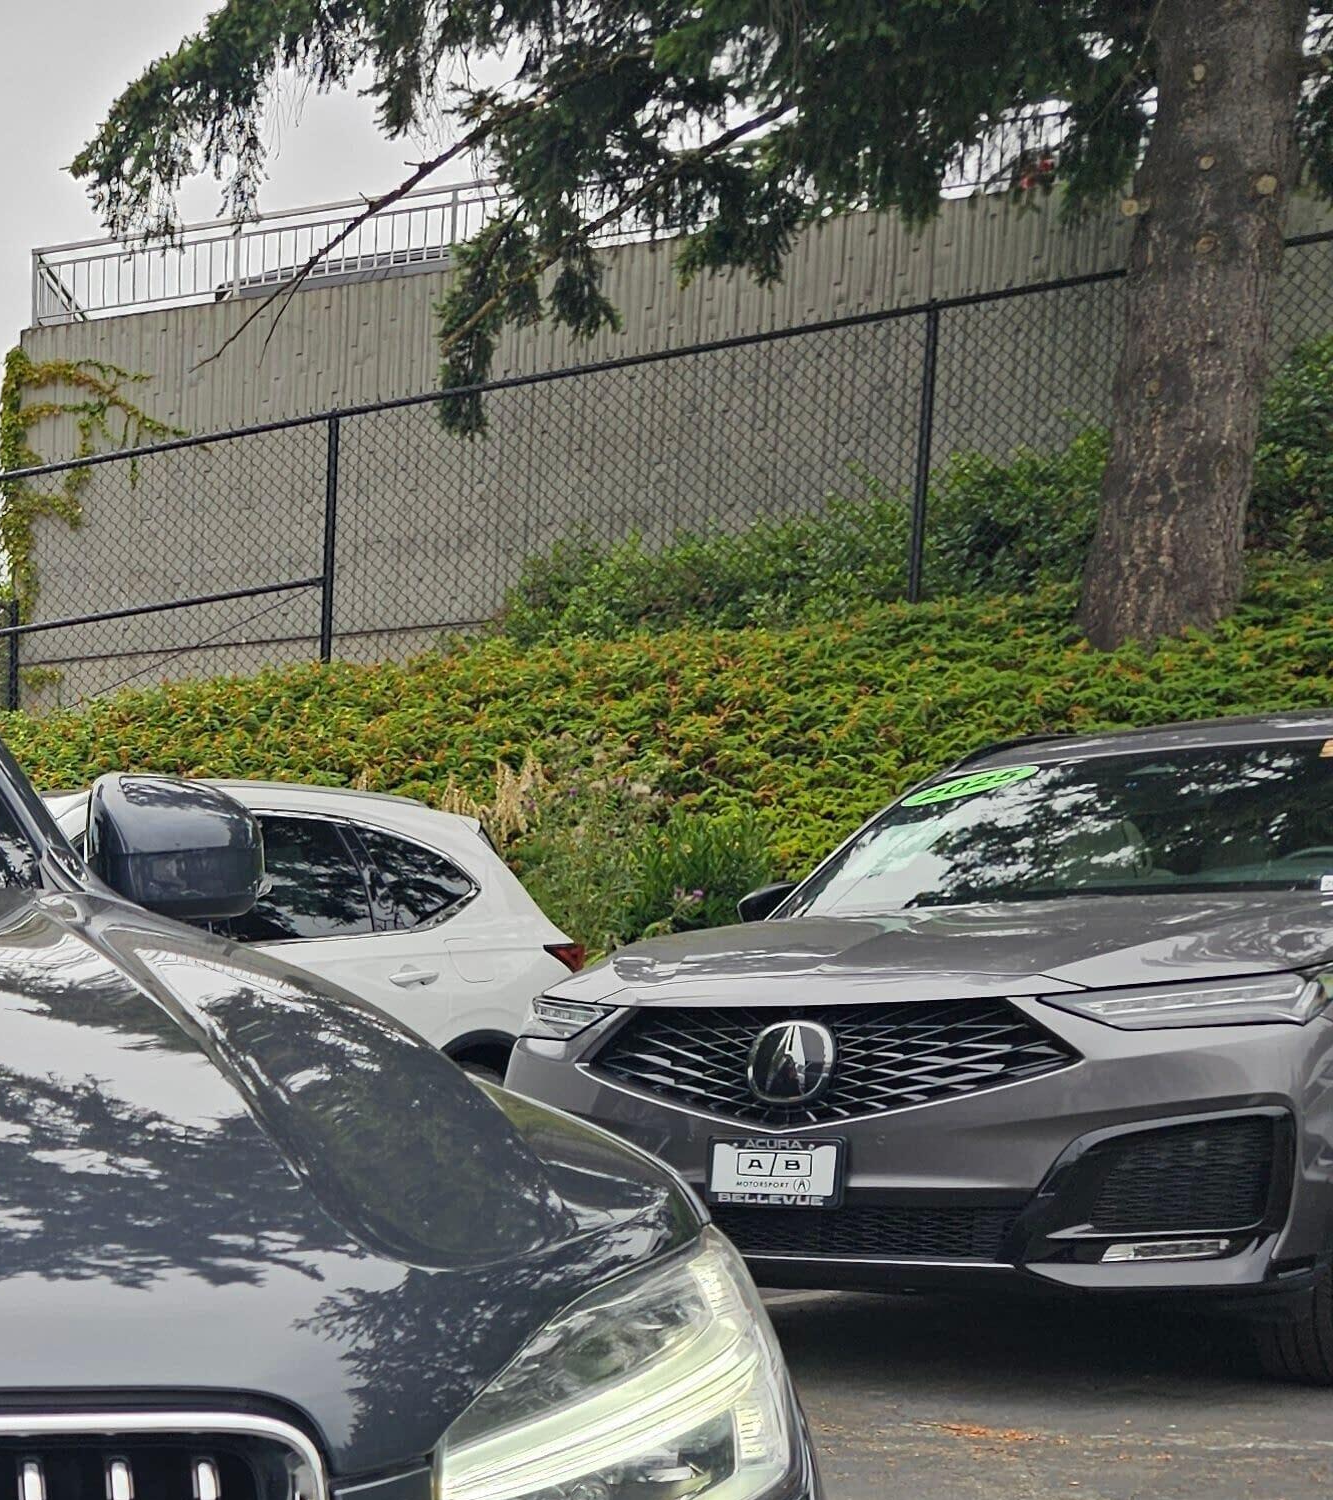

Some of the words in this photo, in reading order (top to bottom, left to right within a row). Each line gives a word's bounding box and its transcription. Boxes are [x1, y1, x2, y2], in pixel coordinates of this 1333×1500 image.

[916, 768, 1023, 802] 2025
[744, 1139, 803, 1149] ACURA
[717, 1192, 824, 1206] BELLEVUE
